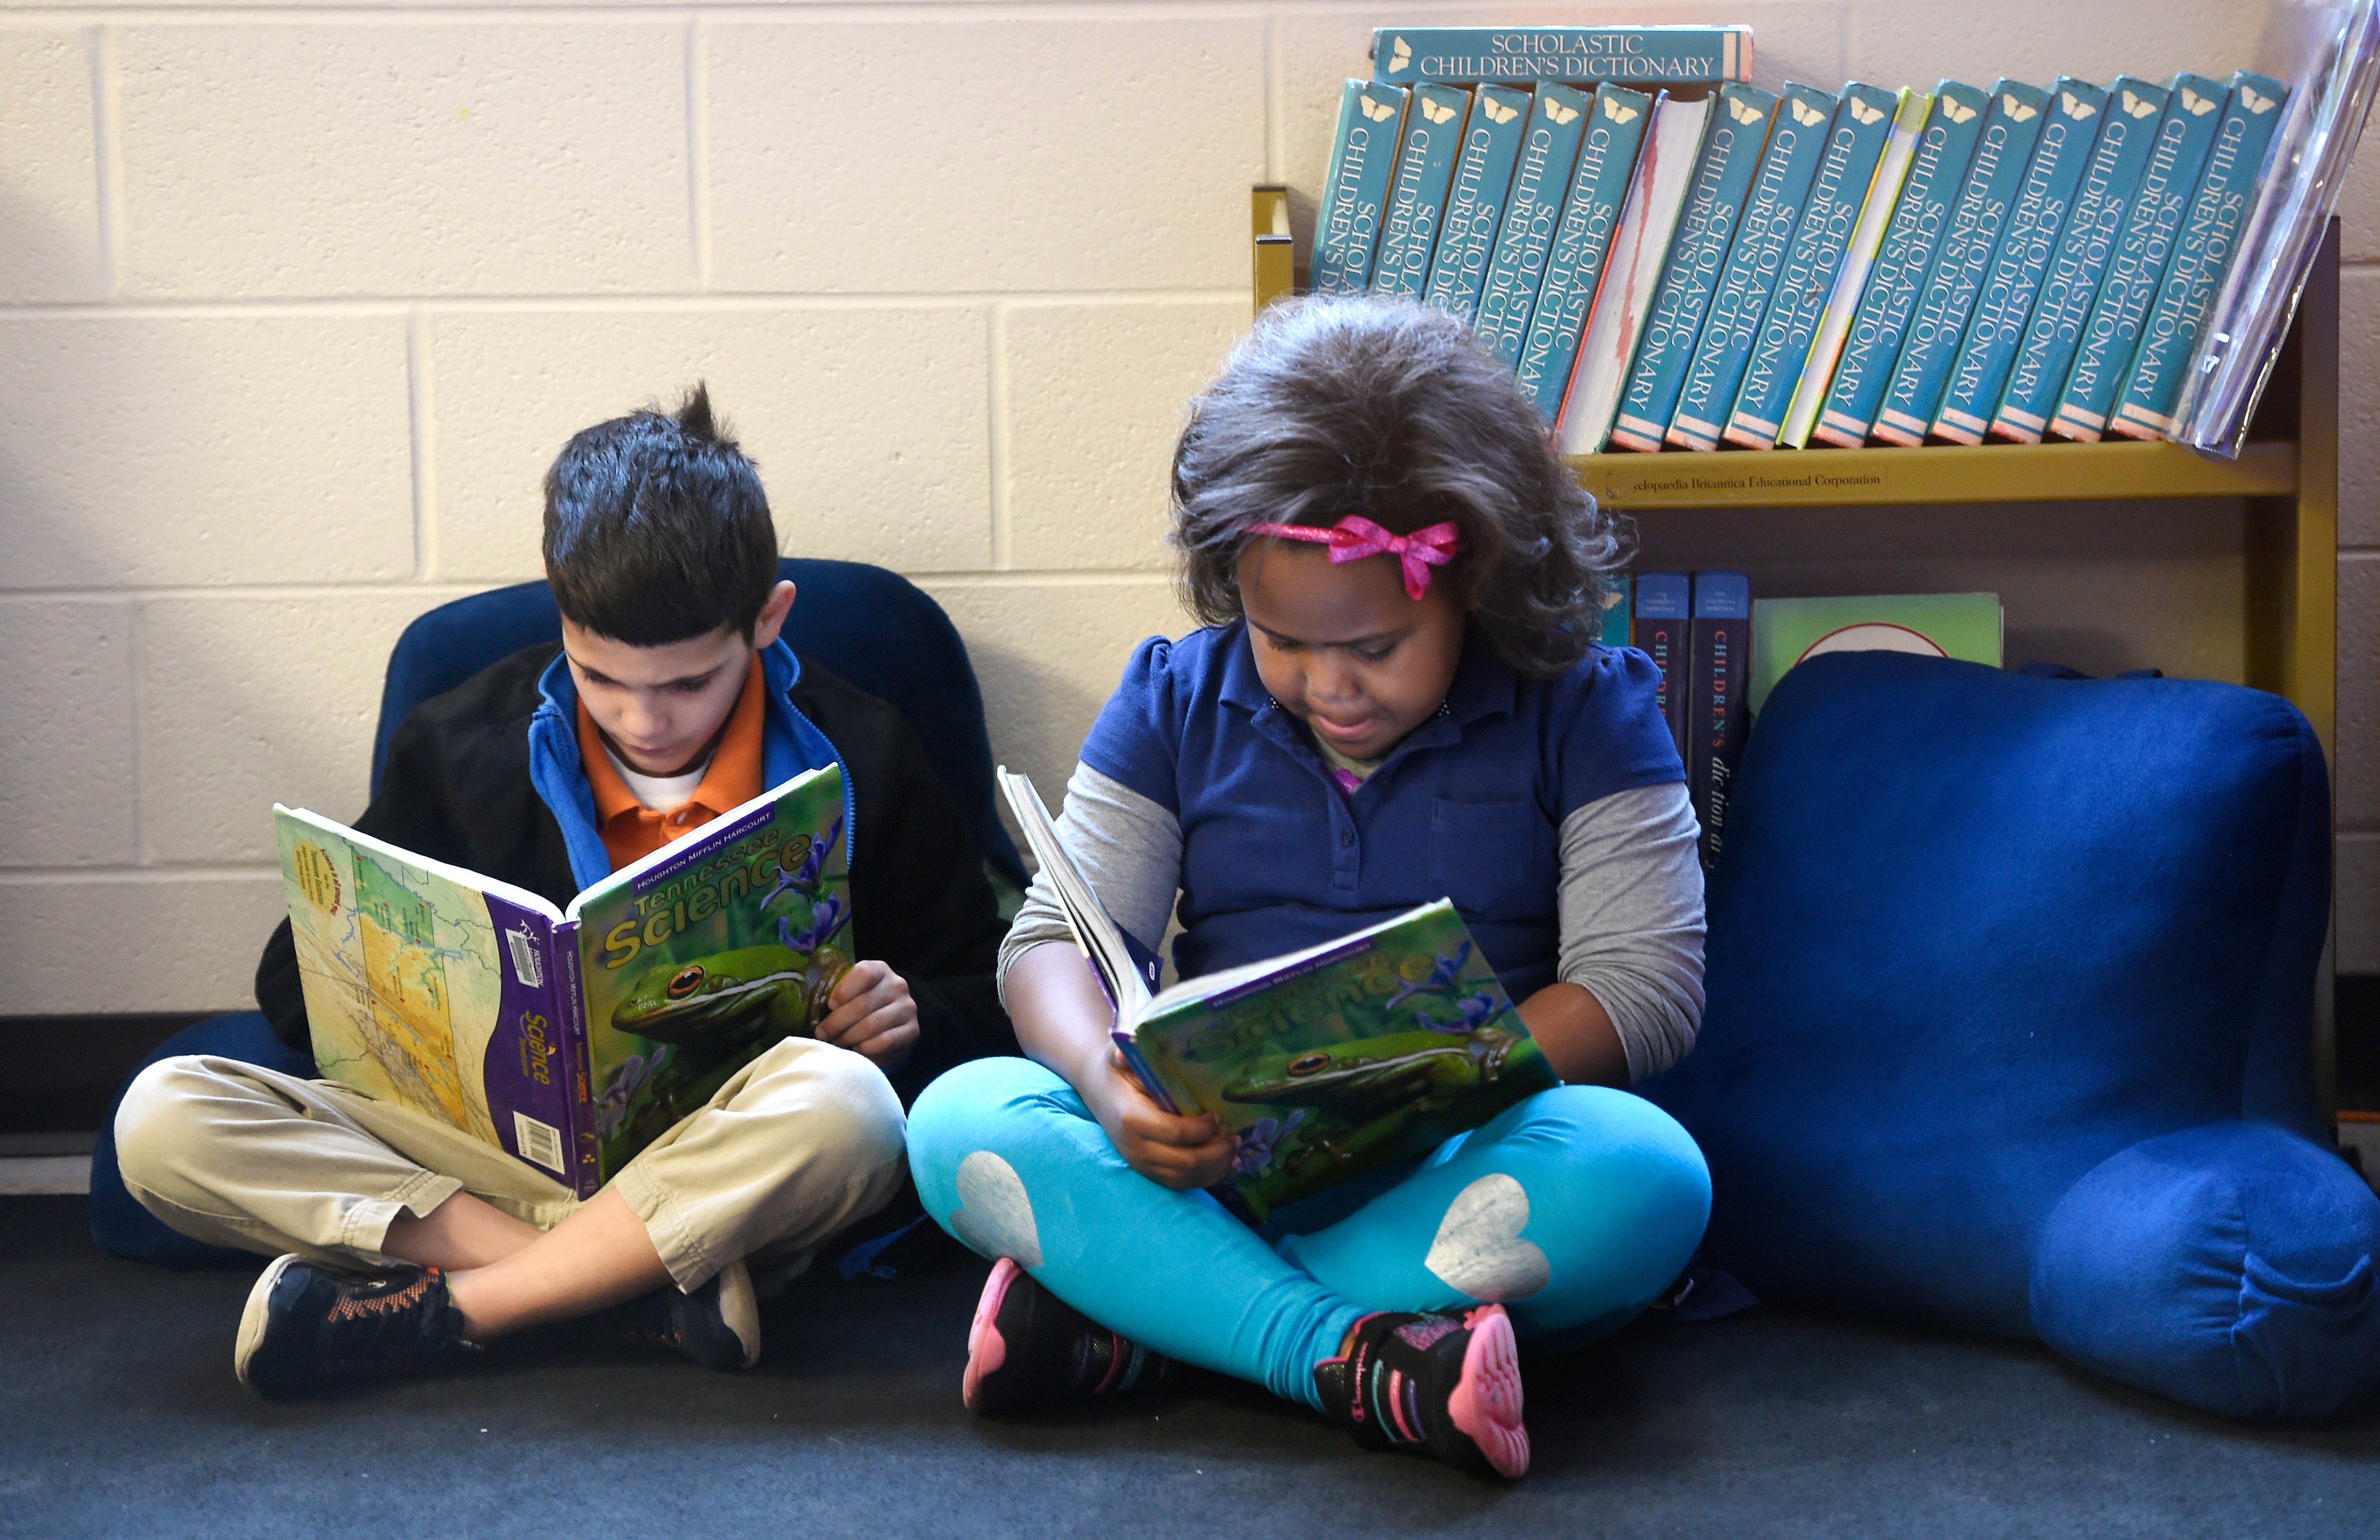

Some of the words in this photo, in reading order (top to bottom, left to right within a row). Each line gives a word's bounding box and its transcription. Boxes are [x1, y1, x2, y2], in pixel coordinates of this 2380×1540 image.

[1420, 57, 1560, 76] CHILDREN'S
[1565, 57, 1715, 77] DICTIONARY
[1492, 35, 1644, 55] SCHOLASTIC
[1326, 128, 1369, 264] CHILDREN'S
[1339, 201, 1376, 296] SCHOLA
[1384, 130, 1429, 265] CHILDREN'S
[1398, 203, 1435, 296] SCHOLA
[1443, 129, 1490, 264] CHILDREN'S
[1501, 129, 1551, 265] CHILDREN'S
[1558, 129, 1609, 263] CHILDREN'S
[1678, 129, 1734, 262] CHILDREN'S
[1738, 130, 1796, 263] CHILDREN'S
[1796, 128, 1854, 261] CHILDREN'S
[1887, 126, 1946, 260] CHILDREN'S
[1947, 125, 2007, 259] CHILDREN'S
[2006, 124, 2066, 257] CHILDREN'S
[2066, 122, 2126, 256] CHILDREN'S
[2125, 119, 2185, 253] CHILDREN'S
[2186, 117, 2245, 252] CHILDREN'S
[1452, 203, 1495, 314] SCHOLAS
[1478, 268, 1514, 351] DICTIO
[1499, 203, 1554, 351] SCHOLASTIC
[1556, 202, 1612, 350] SCHOLASTIC
[1672, 202, 1733, 349] SCHOLASTIC
[1731, 203, 1794, 350] SCHOLASTIC
[1789, 202, 1852, 348] SCHOLASTIC
[1879, 200, 1944, 346] SCHOLASTIC
[1939, 199, 2004, 345] SCHOLASTIC
[1998, 197, 2064, 344] SCHOLASTIC
[2058, 195, 2123, 342] SCHOLASTIC
[2117, 193, 2183, 340] SCHOLASTIC
[2178, 191, 2243, 339] SCHOLASTIC
[1519, 267, 1571, 397] DICTIONAR
[1629, 266, 1688, 410] DICTIONARY
[1688, 266, 1749, 411] DICTIONARY
[1746, 266, 1807, 409] DICTIONARY
[1835, 262, 1899, 407] DICTIONARY
[1895, 261, 1958, 406] DICTIONARY
[1955, 259, 2018, 405] DICTIONARY
[2014, 257, 2078, 403] DICTIONARY
[2073, 256, 2137, 401] DICTIONARY
[2134, 255, 2198, 400] DICTIONARY
[1692, 477, 1746, 489] Britannica
[1749, 475, 1811, 488] Educational
[1815, 474, 1880, 488] Corporation
[1712, 630, 1727, 748] CHILDREN'S
[604, 833, 812, 970] Science
[633, 828, 780, 916] Tennessee
[636, 859, 687, 890] HOUGHTON
[688, 837, 722, 862] MIFFLIN
[724, 812, 771, 842] HARCOURT
[525, 1010, 550, 1085] Science
